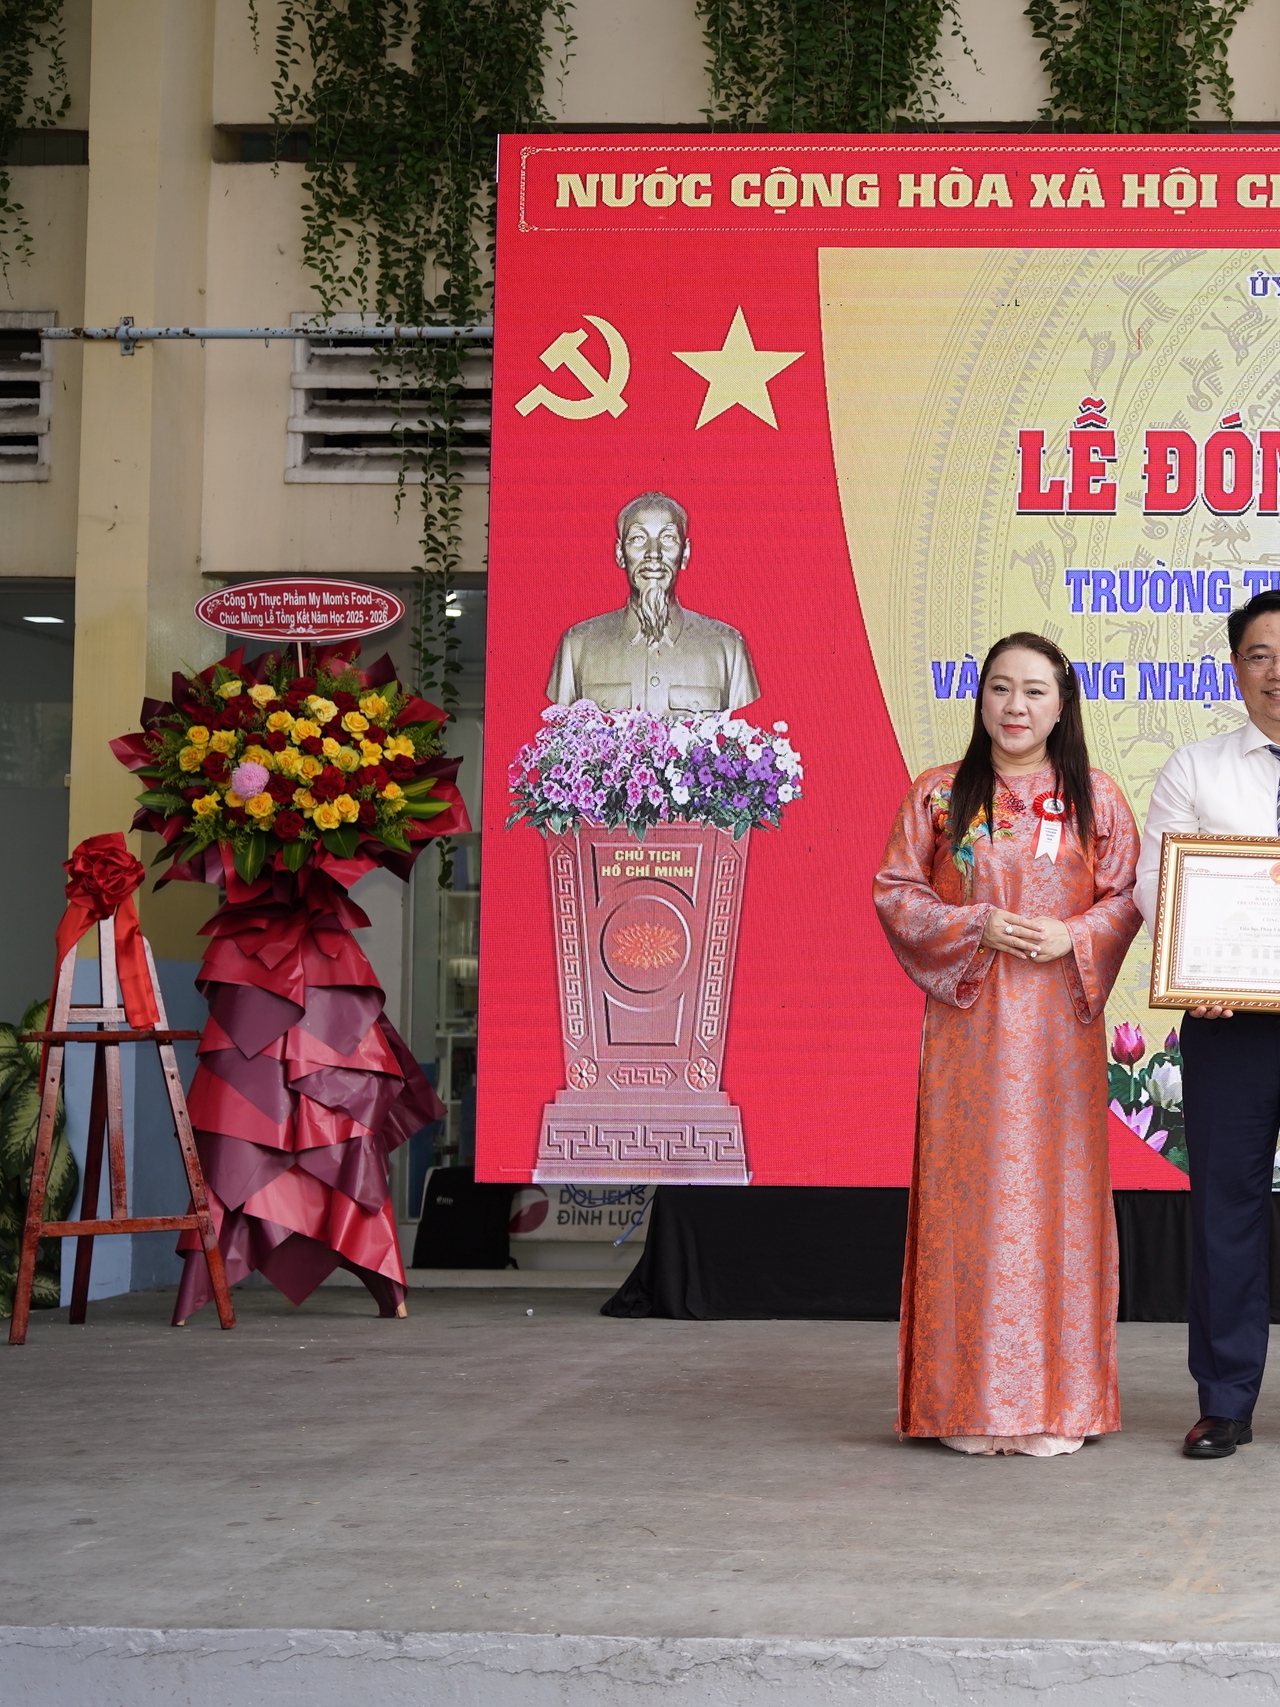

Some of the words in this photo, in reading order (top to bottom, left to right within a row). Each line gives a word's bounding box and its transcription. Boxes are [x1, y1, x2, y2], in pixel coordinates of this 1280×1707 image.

[556, 166, 712, 208] NƯỚC
[730, 166, 880, 214] CỘNG
[898, 166, 1013, 208] HÒA
[1030, 167, 1105, 208] XÃ
[1122, 167, 1218, 215] HỘI
[1016, 397, 1118, 516] LỄ
[1066, 559, 1232, 613] TRƯỜNG
[223, 593, 246, 609] Công
[247, 593, 257, 609] Ty
[259, 592, 281, 609] Thực
[308, 592, 320, 609] My
[351, 592, 372, 605] Food
[219, 611, 240, 625] Chúc
[241, 611, 263, 627] Mừng
[264, 609, 274, 624] Lễ
[296, 608, 310, 624] Kết
[311, 610, 328, 624] Năm
[329, 610, 345, 626] Học
[346, 610, 364, 624] 2025
[370, 610, 388, 624] 2026
[931, 653, 979, 699] VÀ
[615, 847, 643, 861] CHỦ
[648, 850, 681, 863] TỊCH
[625, 864, 650, 877] CHÍ
[655, 866, 694, 877] MINH
[559, 1189, 595, 1206] DOL
[603, 1189, 646, 1206] IELTS
[557, 1206, 602, 1225] ĐÌNH
[609, 1209, 643, 1230] LỰC
